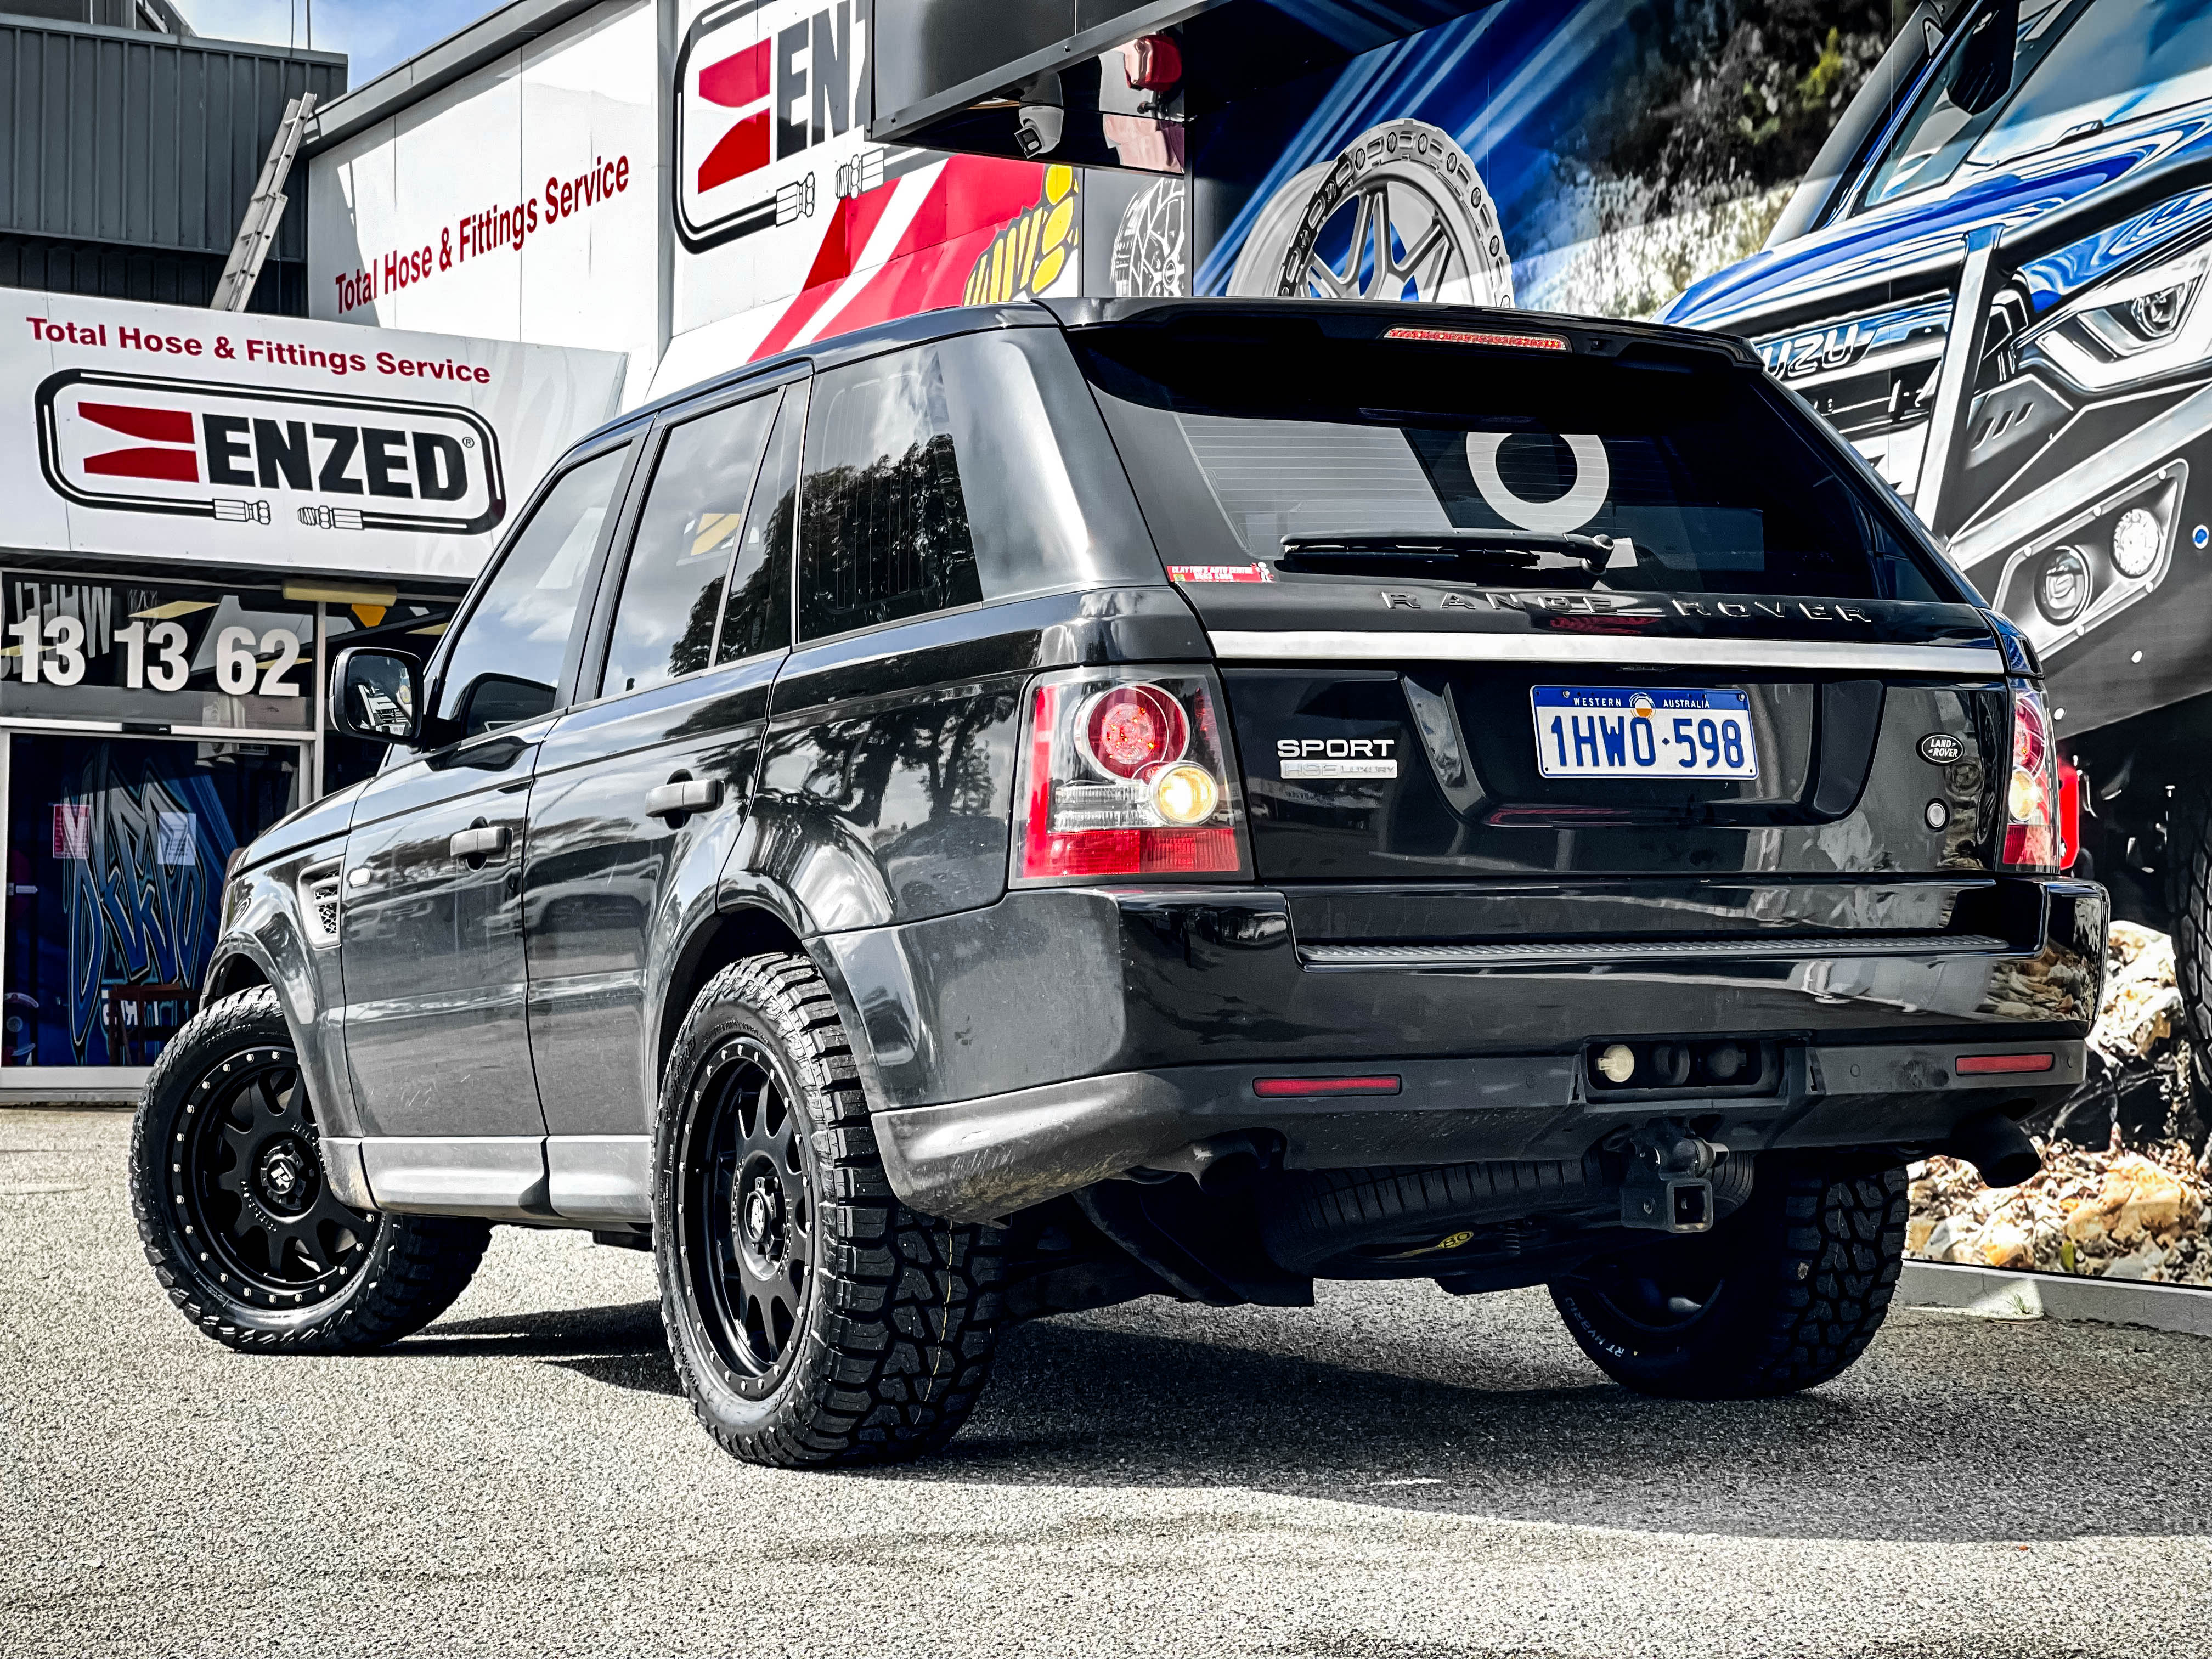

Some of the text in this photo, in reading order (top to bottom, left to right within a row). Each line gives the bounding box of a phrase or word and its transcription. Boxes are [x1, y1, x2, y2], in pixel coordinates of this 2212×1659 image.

[335, 155, 629, 314] Total Hose & Fittings Service
[26, 317, 490, 384] Total Hose & Fittings Service
[1757, 323, 1859, 381] UZU
[1381, 591, 1872, 622] RANGE ROVER
[9, 615, 85, 686] 13
[114, 622, 189, 691] 13
[216, 627, 300, 697] 62
[1573, 697, 1711, 709] WESTERN AUSTRALIA
[1277, 739, 1395, 758] SPORT
[1931, 738, 1952, 748] LAND
[1932, 748, 1958, 757] ROVER
[1284, 763, 1396, 776] HSE LUXURY
